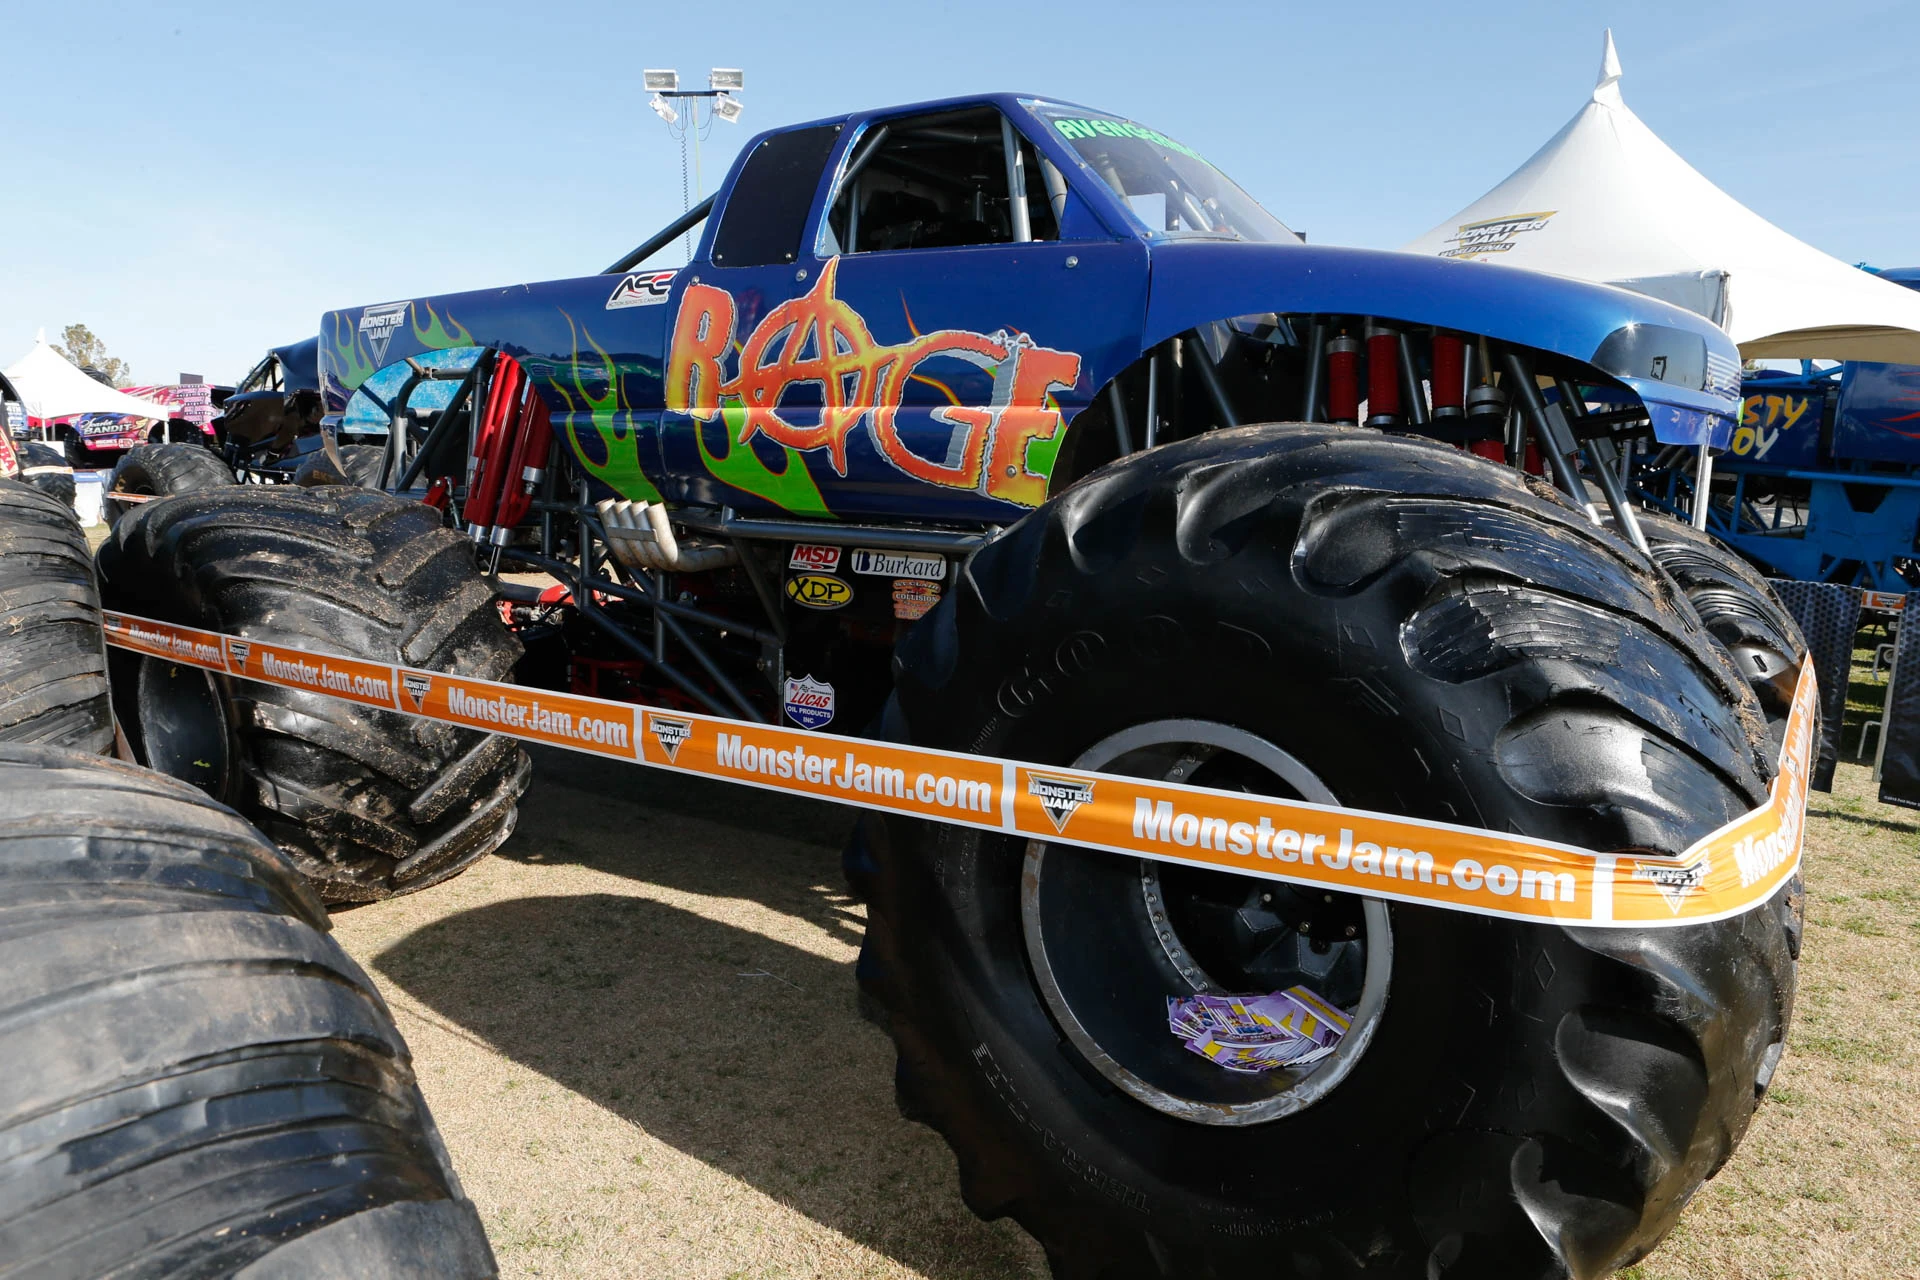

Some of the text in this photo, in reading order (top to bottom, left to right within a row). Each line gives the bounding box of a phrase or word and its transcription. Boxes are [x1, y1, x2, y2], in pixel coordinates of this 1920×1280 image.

[1450, 221, 1549, 240] MONSTER
[1463, 233, 1510, 246] JAM
[1477, 243, 1513, 252] FINALS
[360, 311, 405, 330] MONSTER
[370, 326, 391, 340] JAM
[664, 255, 1082, 510] RAGE
[1744, 394, 1808, 430] STY
[84, 423, 132, 434] BANDIT
[1732, 426, 1779, 460] OY
[793, 545, 839, 564] MSD
[872, 553, 943, 577] Burkard
[791, 576, 845, 602] XDP
[895, 593, 937, 602] COLLISION
[262, 651, 390, 700] MonsterJam.com
[403, 680, 430, 691] MONSTER
[411, 689, 423, 697] JAM
[790, 691, 831, 708] LUCAS
[448, 686, 628, 748] MonsterJam.com
[787, 705, 831, 718] OIL PRODUCTS
[650, 722, 691, 738] MONSTER
[660, 734, 679, 745] JAM
[716, 732, 992, 813] MonsterJam.com
[1029, 782, 1093, 802] MONSTER
[1045, 797, 1074, 811] JAM
[1132, 796, 1576, 903] MonsterJam.com
